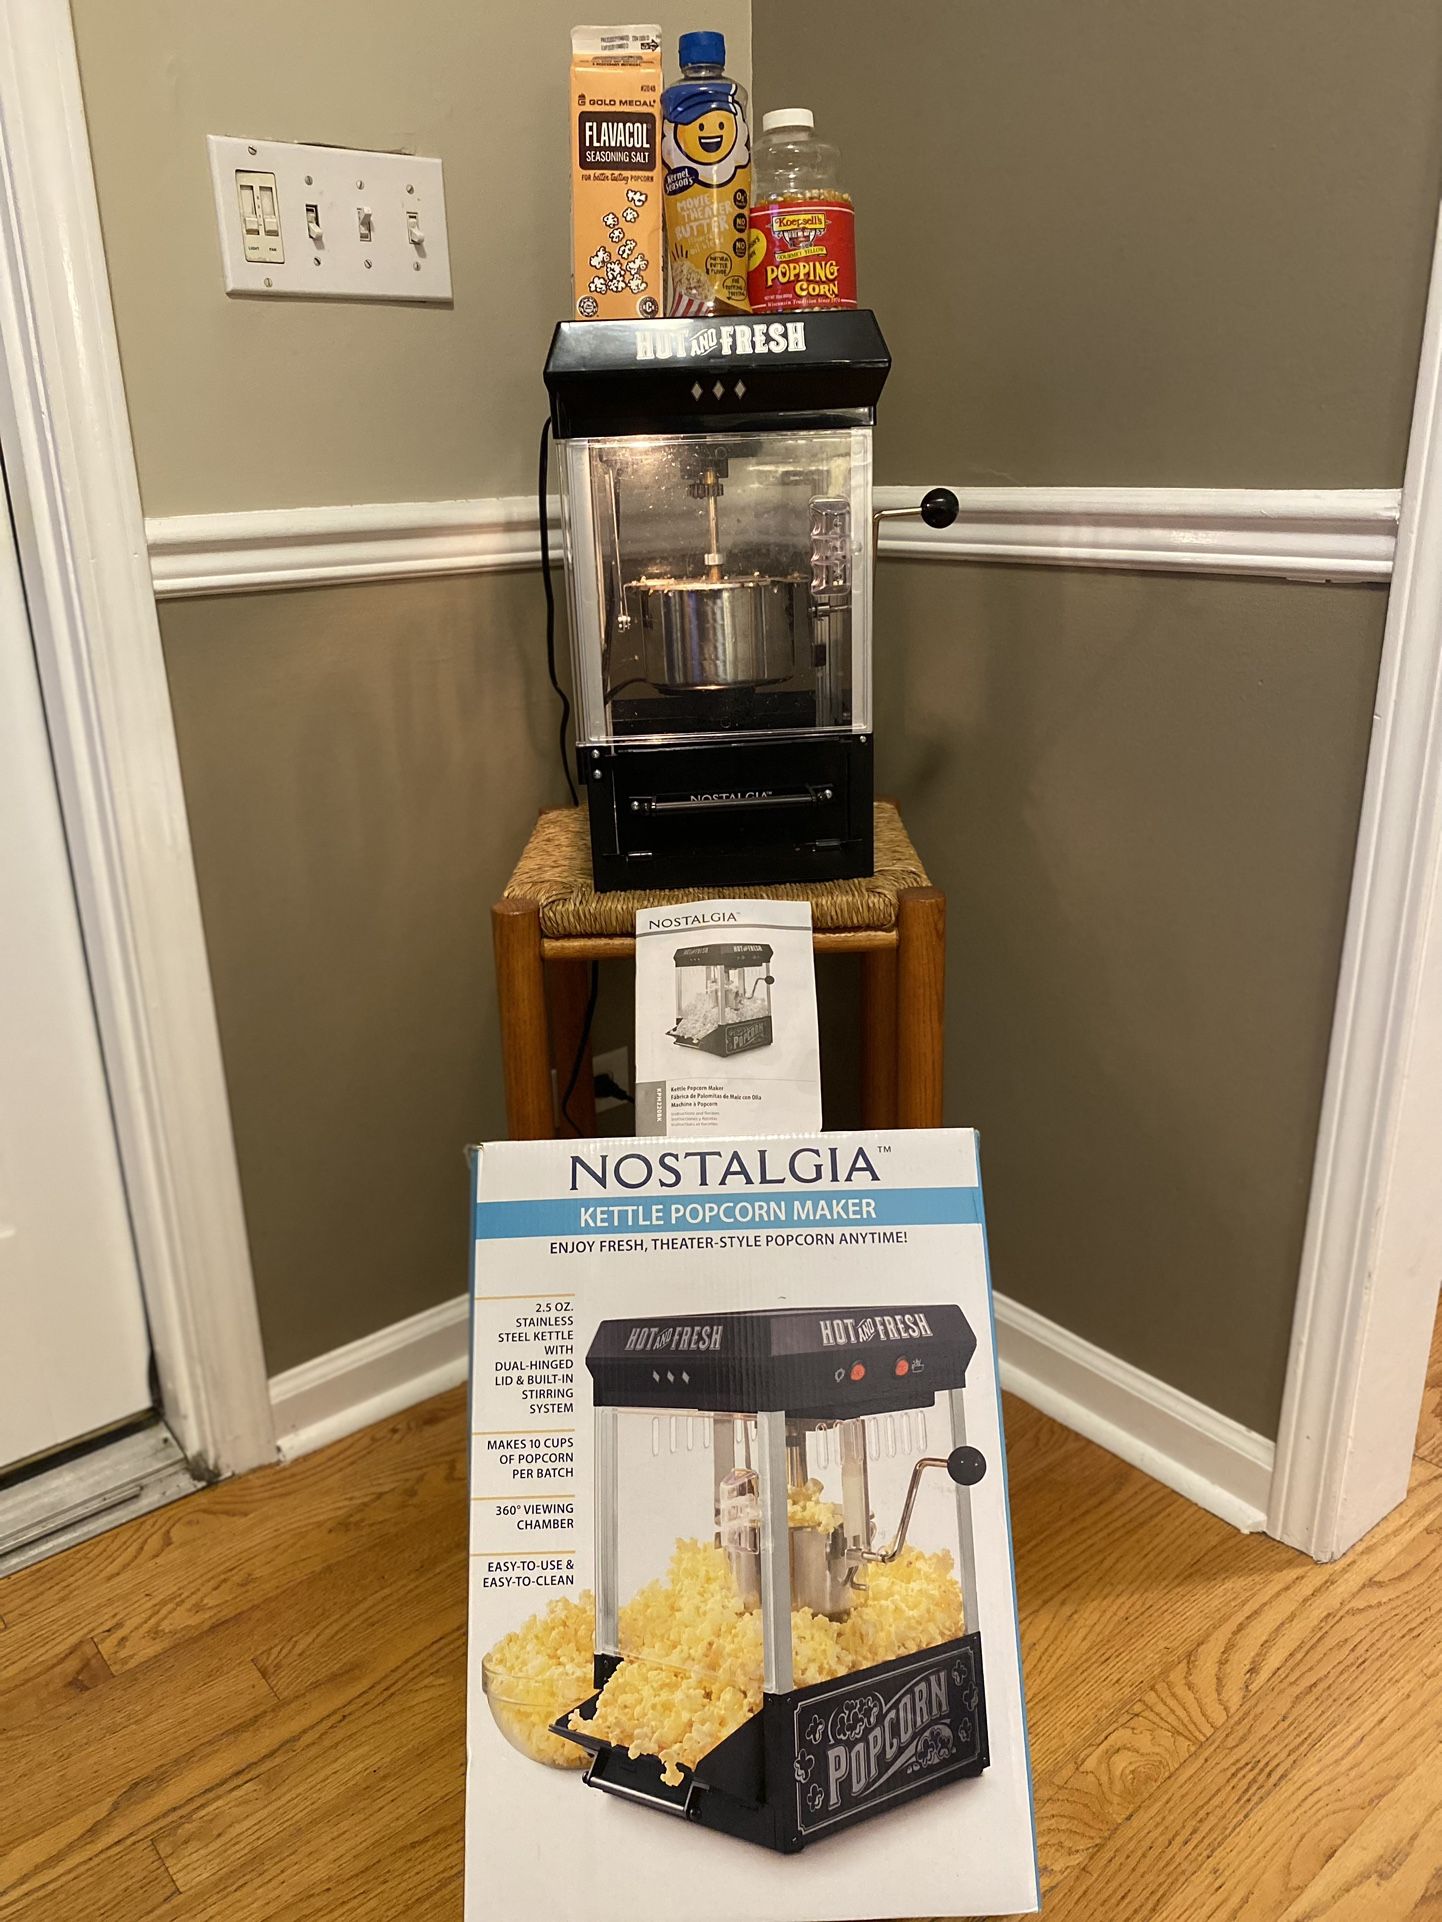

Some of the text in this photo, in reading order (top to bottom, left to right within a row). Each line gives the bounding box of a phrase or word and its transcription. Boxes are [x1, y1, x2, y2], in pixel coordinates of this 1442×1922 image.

[619, 99, 654, 107] MEDAL
[585, 121, 650, 148] FLAVACOL
[586, 151, 649, 163] SEASONING SALT
[667, 168, 690, 184] Kernel
[677, 193, 711, 212] MOVIE
[675, 215, 729, 240] BUTTER
[766, 260, 839, 287] POPPING
[795, 281, 838, 298] CORN
[635, 322, 806, 360] HOT AND FRESH
[580, 1199, 876, 1227] KETTLE POPCORN MAKER
[550, 1231, 908, 1254] ENJOY FRESH, THEATER-STYLE POPCORN ANYTIME!
[536, 1302, 574, 1312] 2.5 OZ.
[516, 1316, 573, 1327] STAINLESS
[819, 1313, 933, 1346] HOT AND FRESH
[498, 1330, 573, 1342] STEEL KETTLE
[624, 1325, 723, 1350] HOT AND FRESH
[544, 1345, 573, 1355] WITH
[495, 1359, 573, 1371] DUAL-HINGED
[495, 1374, 573, 1386] LID & BUILT-IN
[522, 1388, 573, 1399] STIRRING
[530, 1403, 573, 1414] SYSTEM
[487, 1438, 573, 1450] MAKES 10 CUPS
[500, 1453, 573, 1464] OF POPCORN
[513, 1468, 573, 1479] PER BATCH
[496, 1503, 573, 1515] 360° VIEWING
[517, 1518, 574, 1530] CHAMBER
[488, 1559, 574, 1572] EASY-TO-USE &
[483, 1575, 574, 1588] EASY-TO-CLEAN
[827, 1670, 950, 1811] POPCORN
